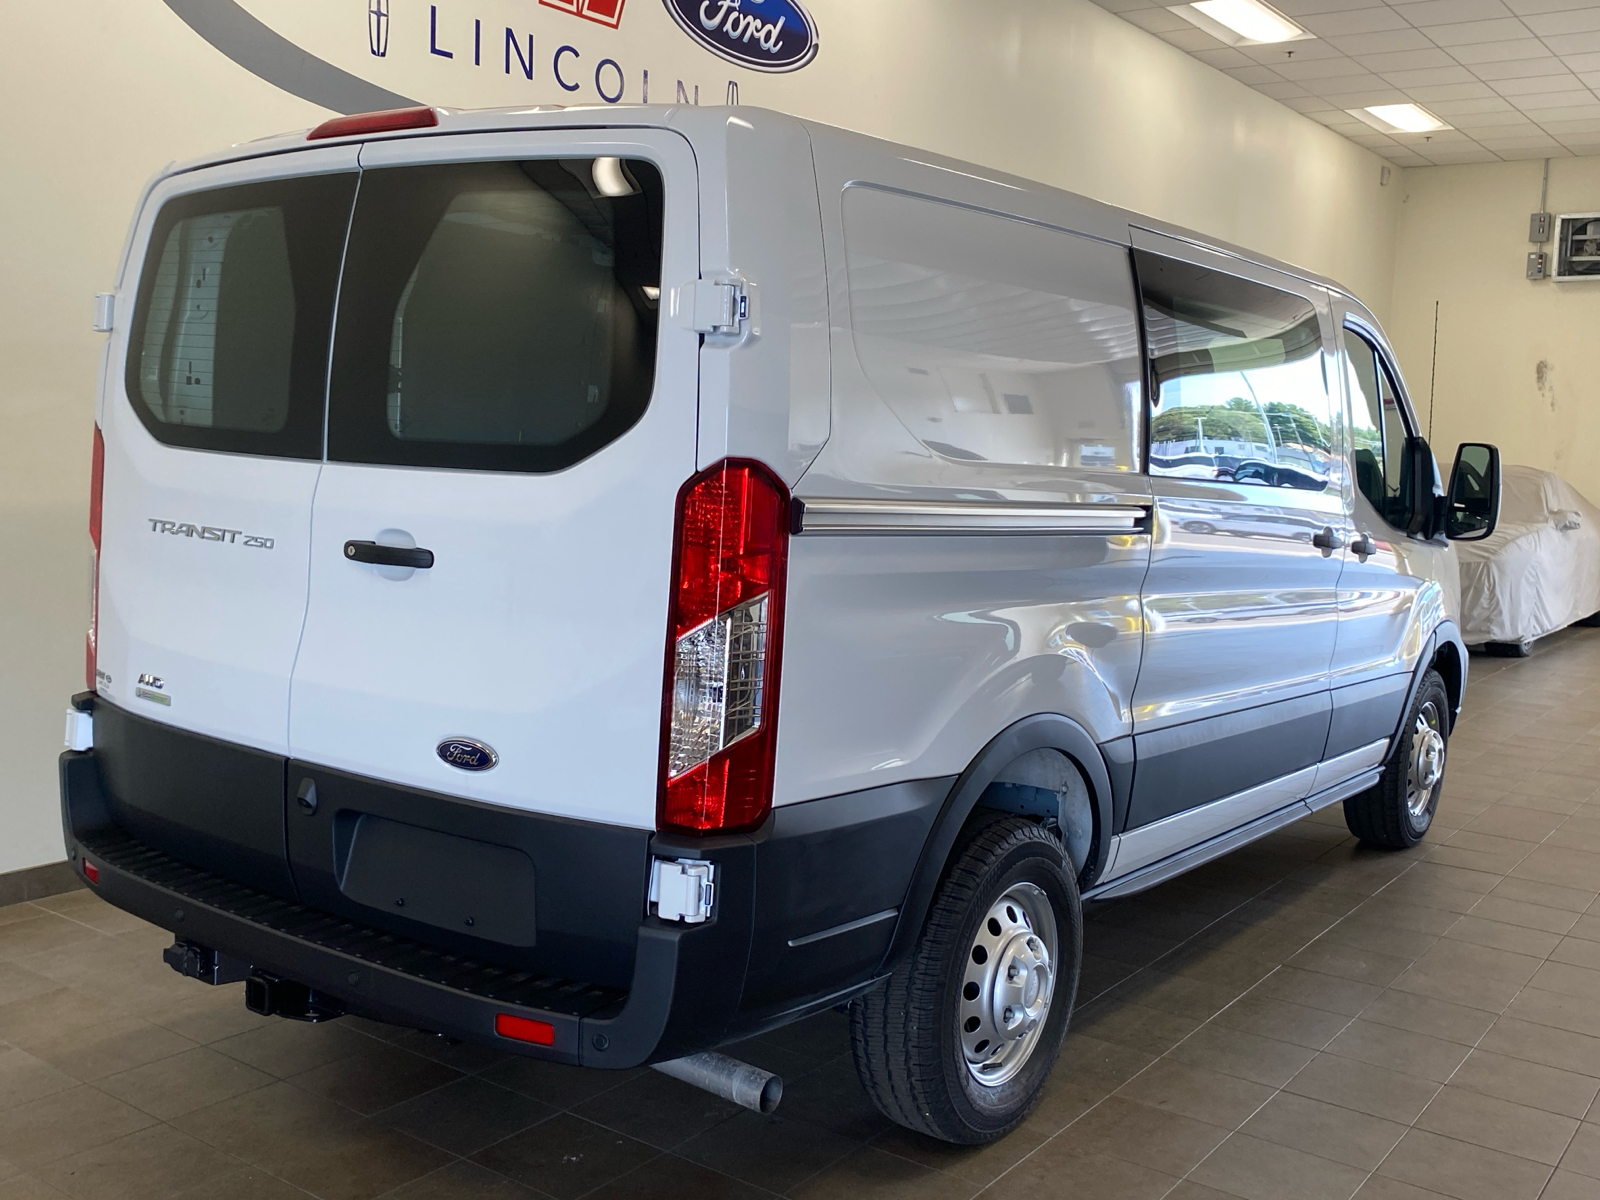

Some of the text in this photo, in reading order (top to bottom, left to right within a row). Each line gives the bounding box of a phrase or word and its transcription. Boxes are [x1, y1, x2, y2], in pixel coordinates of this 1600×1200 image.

[148, 518, 275, 550] TRANSIT 250
[446, 743, 481, 766] Ford
